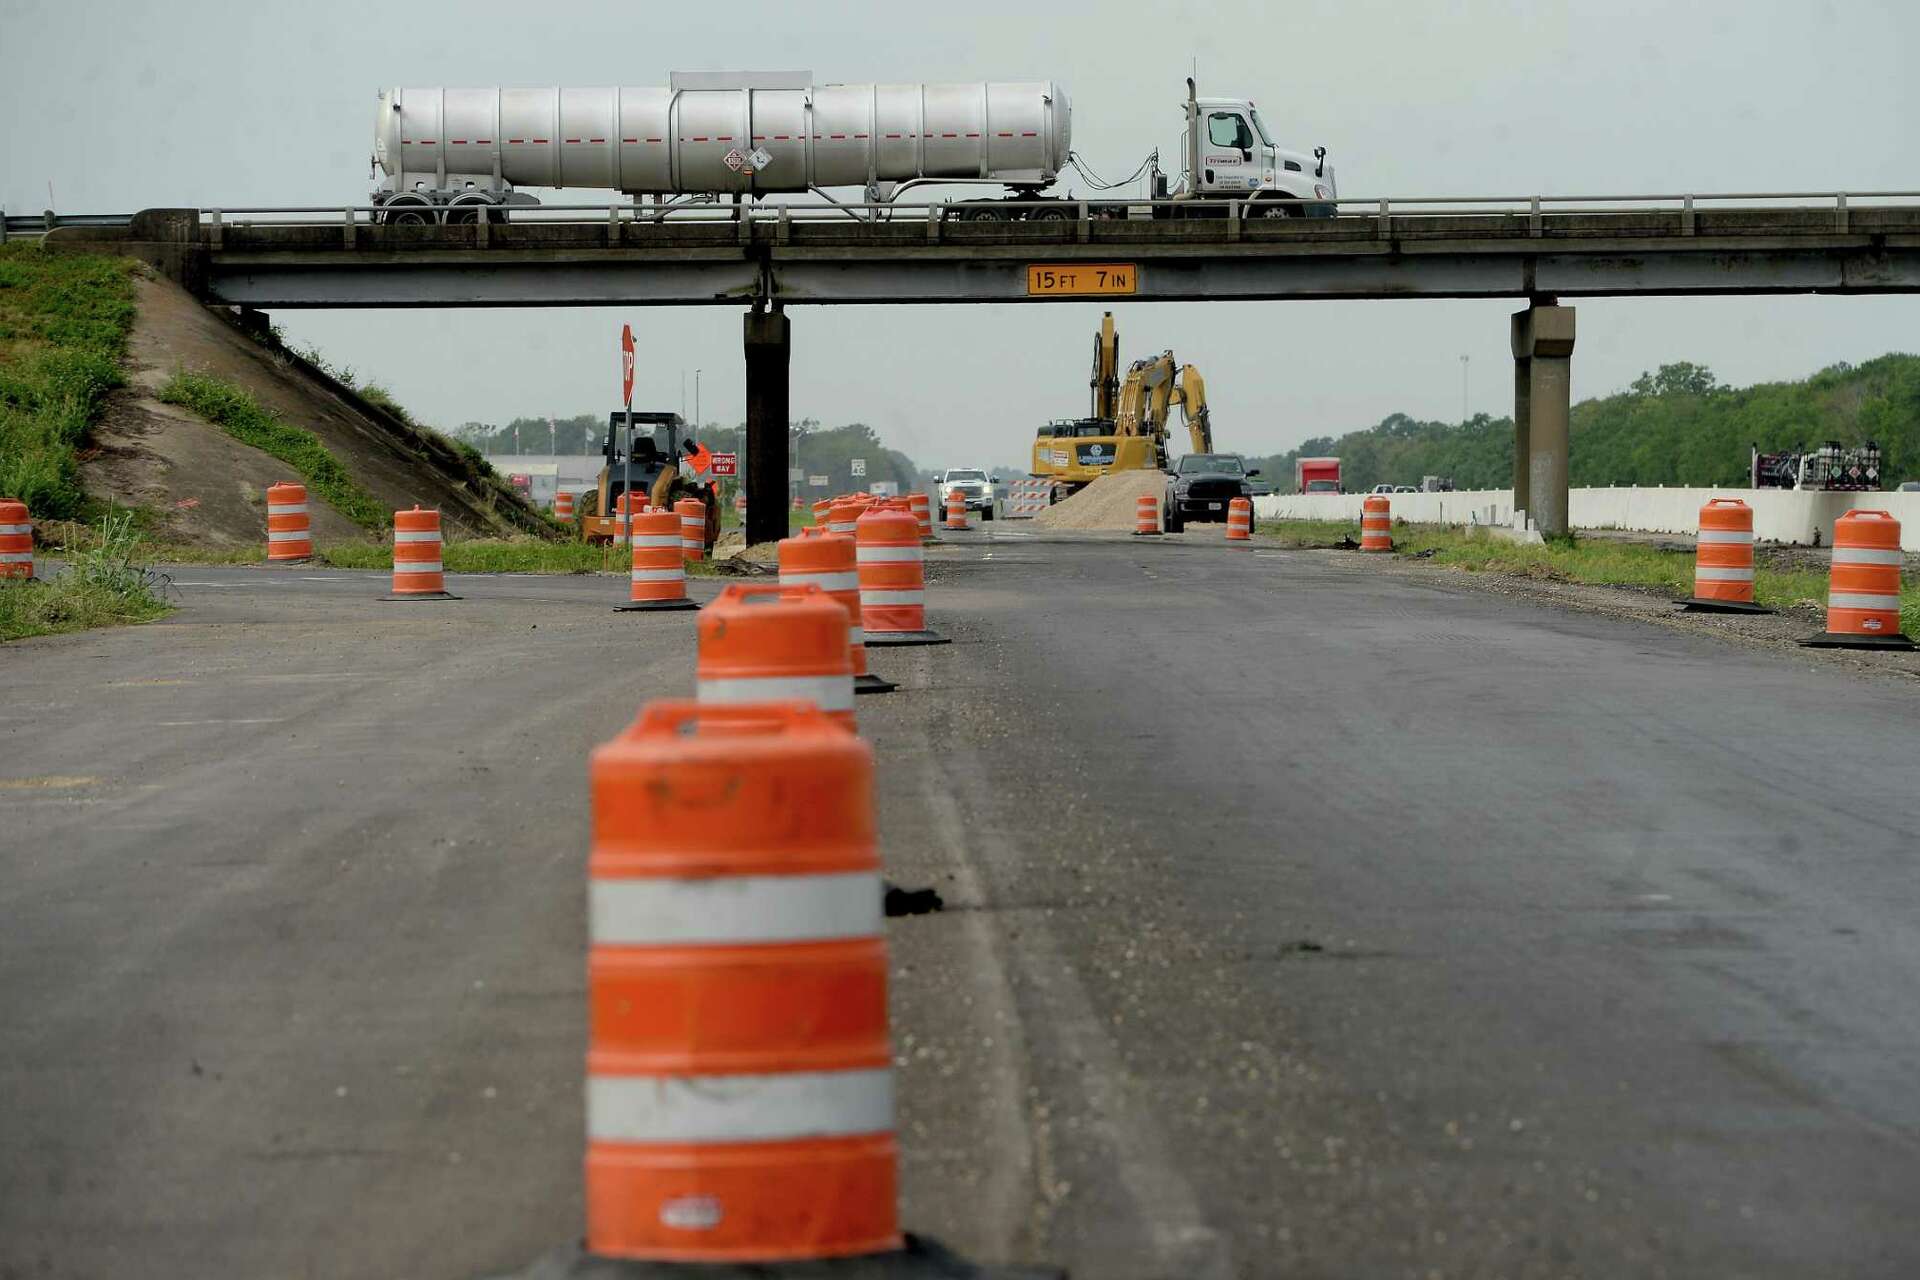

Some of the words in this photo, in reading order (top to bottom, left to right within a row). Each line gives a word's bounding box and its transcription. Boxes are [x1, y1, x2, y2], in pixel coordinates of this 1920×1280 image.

[1036, 272, 1055, 288] 15
[1060, 275, 1077, 288] FT
[1096, 271, 1107, 287] 7
[1112, 274, 1126, 287] IN
